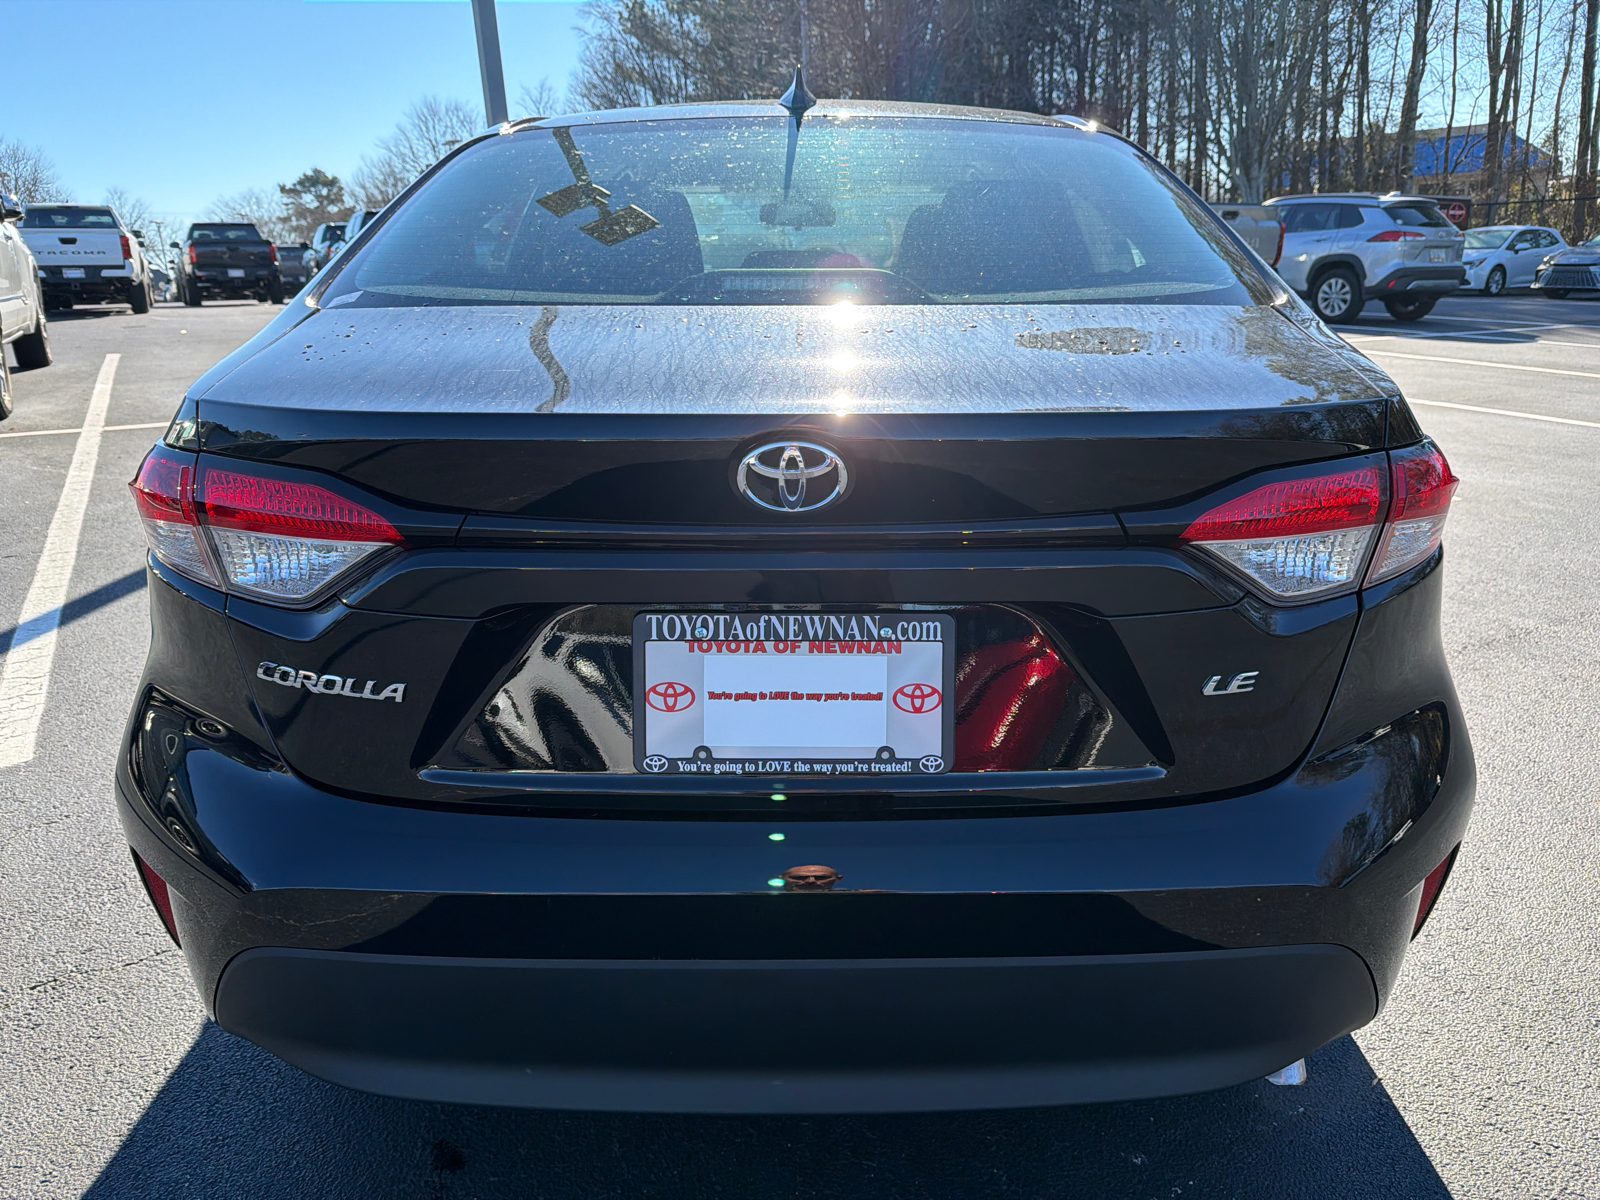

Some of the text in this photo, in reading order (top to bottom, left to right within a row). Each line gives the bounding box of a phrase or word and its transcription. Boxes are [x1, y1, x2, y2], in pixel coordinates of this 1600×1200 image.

[685, 640, 902, 654] TOYOTA OF NEWNAN
[256, 661, 407, 702] COROLLA
[1202, 671, 1260, 696] LE
[708, 691, 883, 702] You're going to LOVE the way you're treated!
[677, 760, 912, 774] You're going to LOVE the way you're treated!
